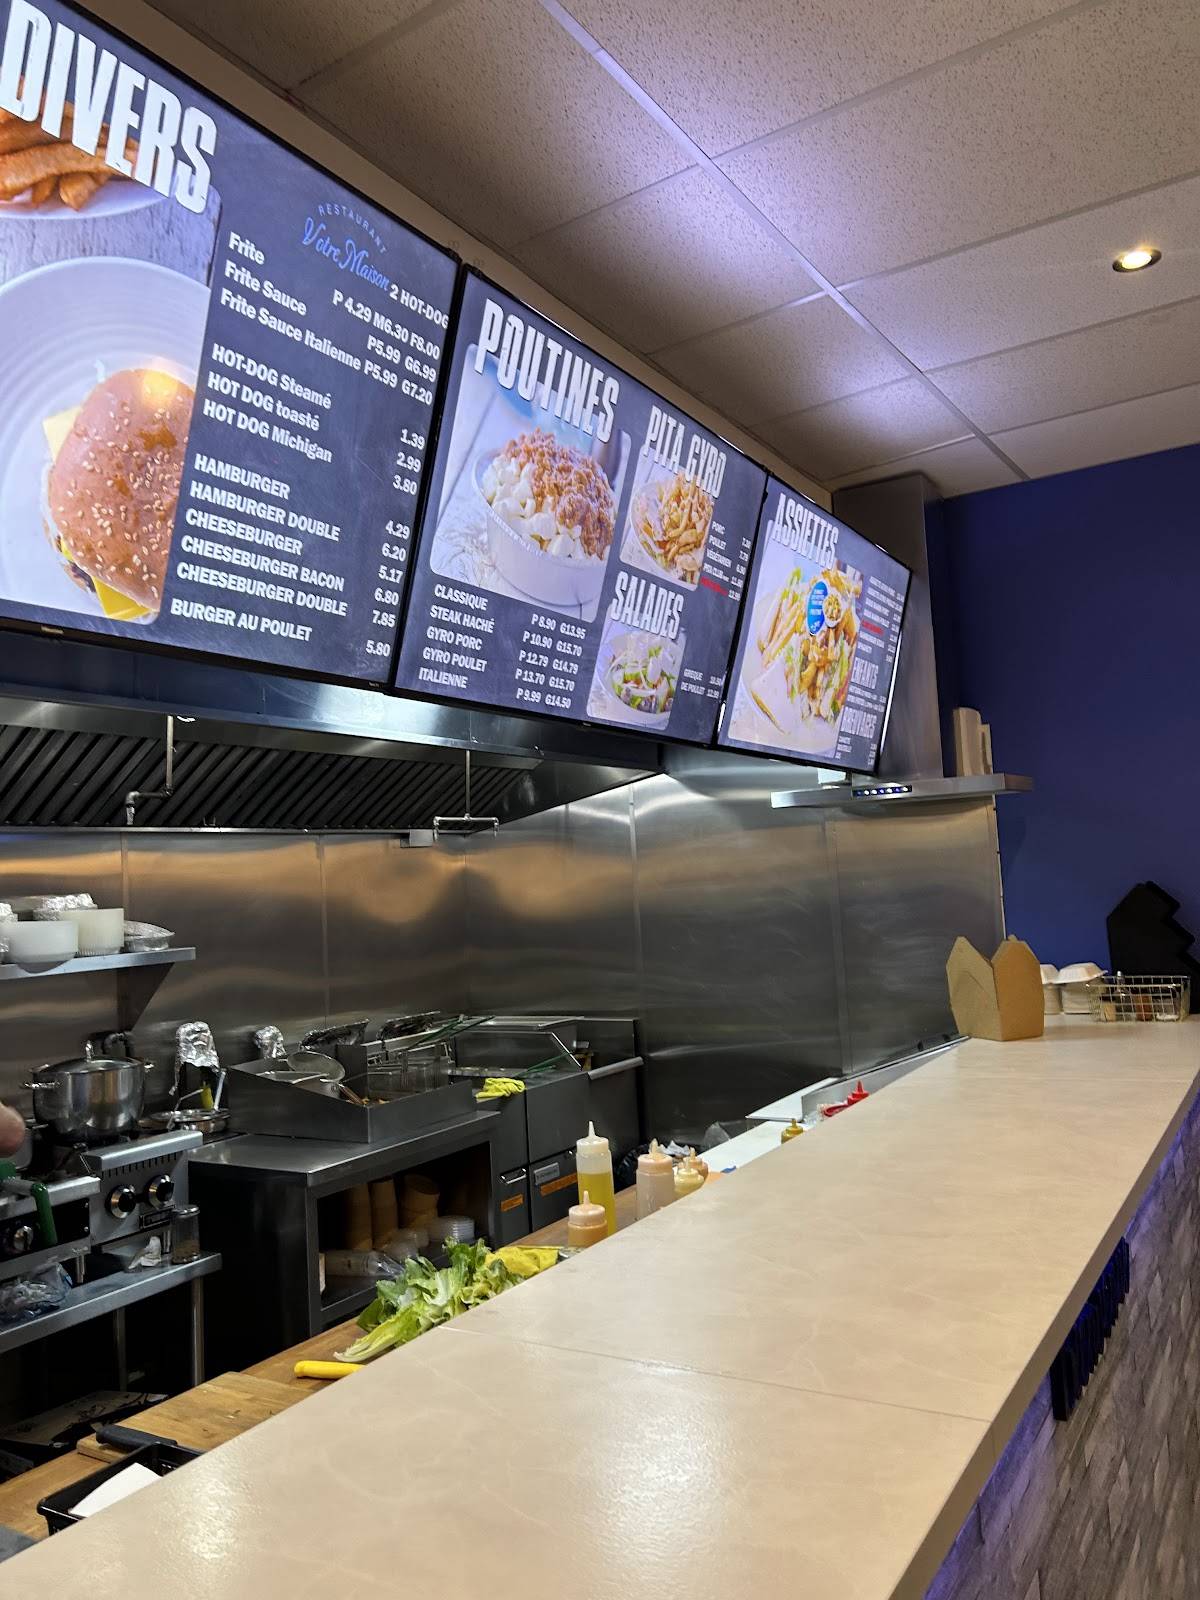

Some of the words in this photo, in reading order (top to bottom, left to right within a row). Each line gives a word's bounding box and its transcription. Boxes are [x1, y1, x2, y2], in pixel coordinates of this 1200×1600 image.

[0, 0, 217, 214] DIVERS
[302, 217, 341, 262] Votre
[339, 238, 390, 291] Maison
[318, 204, 387, 254] RESTAURANT
[224, 259, 261, 292] Frite
[262, 280, 307, 316] Sauce
[367, 334, 401, 364] P5.99
[404, 355, 437, 383] G6.99
[229, 231, 265, 265] Frite
[332, 289, 344, 306] P
[344, 297, 372, 323] 4.29
[373, 311, 409, 343] M6.30
[410, 332, 440, 360] F8.00
[390, 284, 399, 300] 2
[400, 289, 449, 329] HOT-DOG
[220, 287, 257, 319] Frite
[258, 307, 303, 341] Sauce
[304, 329, 362, 371] Italienne
[363, 359, 398, 388] P5.99
[401, 379, 433, 406] G7.20
[474, 298, 620, 443] POUTINES
[207, 370, 241, 399] HOT
[240, 384, 274, 414] DOG
[275, 399, 320, 432] toasté
[396, 452, 422, 473] 2.99
[211, 342, 279, 387] HOT-DOG
[279, 373, 332, 410] Steamé
[400, 428, 426, 450] 1.39
[202, 398, 237, 426] HOT
[236, 411, 270, 439] DOG
[271, 425, 333, 463] Michigan
[392, 474, 418, 496] 3.80
[643, 405, 685, 475] PITA
[685, 433, 727, 500] GYRO
[189, 480, 286, 525] HAMBURGER
[287, 511, 341, 542] DOUBLE
[381, 542, 407, 562] 6.20
[193, 453, 291, 500] HAMBURGER
[385, 519, 411, 540] 4.29
[711, 521, 726, 535] PORC
[771, 492, 839, 571] ASSIETTES
[180, 534, 299, 581] CHEESEBURGER
[299, 566, 345, 592] BACON
[374, 587, 400, 606] 6.80
[185, 508, 304, 556] CHEESEBURGER
[378, 564, 404, 584] 5.17
[708, 535, 727, 551] POULET
[170, 597, 237, 627] BURGER
[236, 613, 260, 631] AU
[259, 617, 313, 642] POULET
[365, 639, 391, 657] 5.80
[176, 561, 295, 605] CHEESEBURGER
[295, 590, 348, 617] DOUBLE
[372, 609, 397, 628] 7.85
[429, 604, 461, 625] STEAK
[462, 617, 495, 634] HACHÉ
[522, 630, 531, 643] P
[531, 634, 553, 649] 10.90
[556, 640, 583, 657] G15.70
[434, 583, 489, 611] CLASSIQUE
[531, 613, 539, 625] P
[538, 615, 557, 631] 8.90
[560, 622, 587, 640] G13.95
[610, 571, 685, 641] SALADES
[422, 646, 451, 664] GYRO
[451, 654, 488, 673] POULET
[514, 668, 522, 680] P
[523, 670, 546, 686] 13.70
[548, 676, 576, 692] G15.70
[426, 625, 455, 644] GYRO
[455, 637, 483, 651] PORC
[518, 649, 527, 662] P
[526, 651, 549, 668] 12.79
[552, 658, 579, 675] G14.79
[418, 667, 469, 689] ITALIENNE
[516, 687, 524, 700] P
[523, 689, 542, 703] 9.99
[545, 694, 572, 709] G14.50
